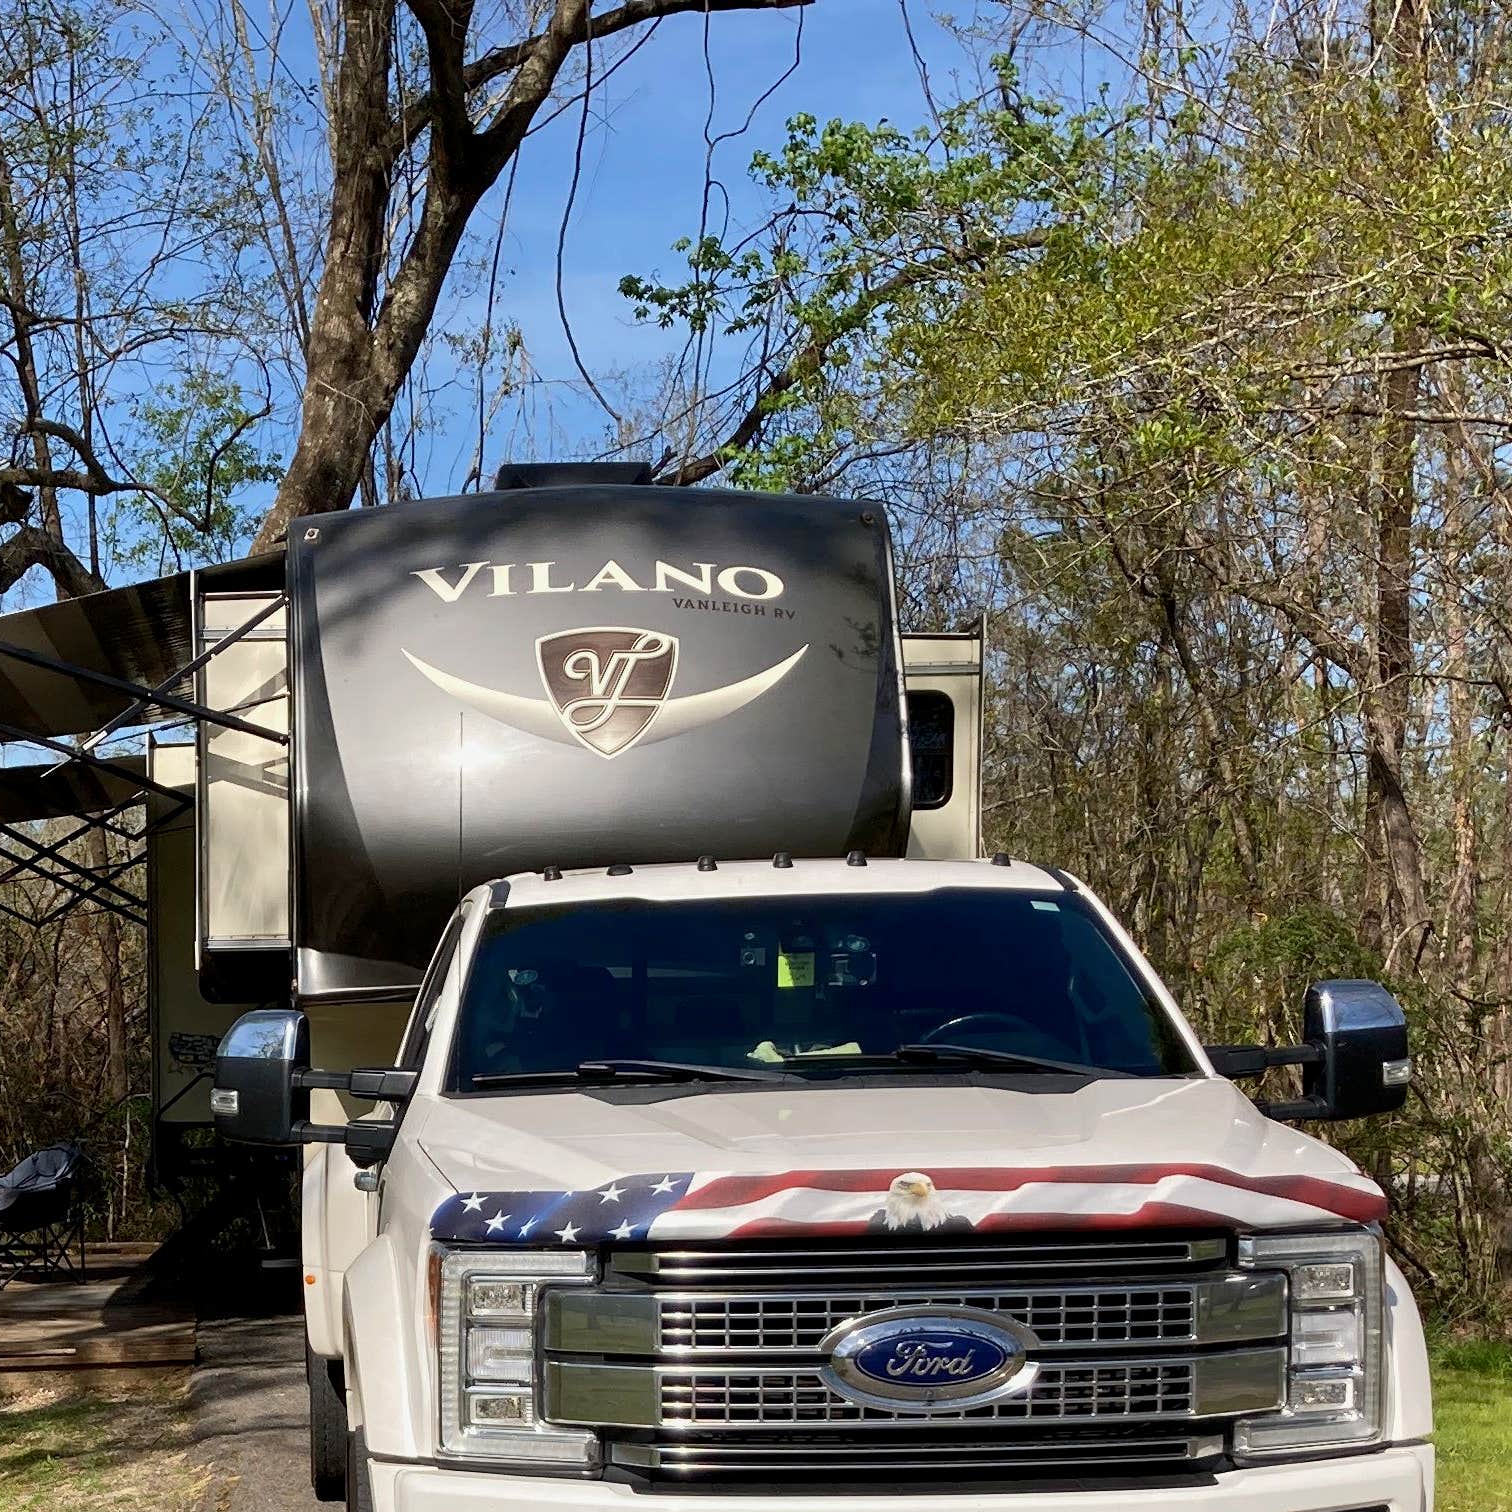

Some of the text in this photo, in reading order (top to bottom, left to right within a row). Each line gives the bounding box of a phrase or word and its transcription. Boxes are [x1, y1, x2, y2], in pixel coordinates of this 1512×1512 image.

[410, 559, 784, 602] VILANO
[672, 598, 796, 620] VANLEIGH RV
[886, 1340, 976, 1376] Ford
